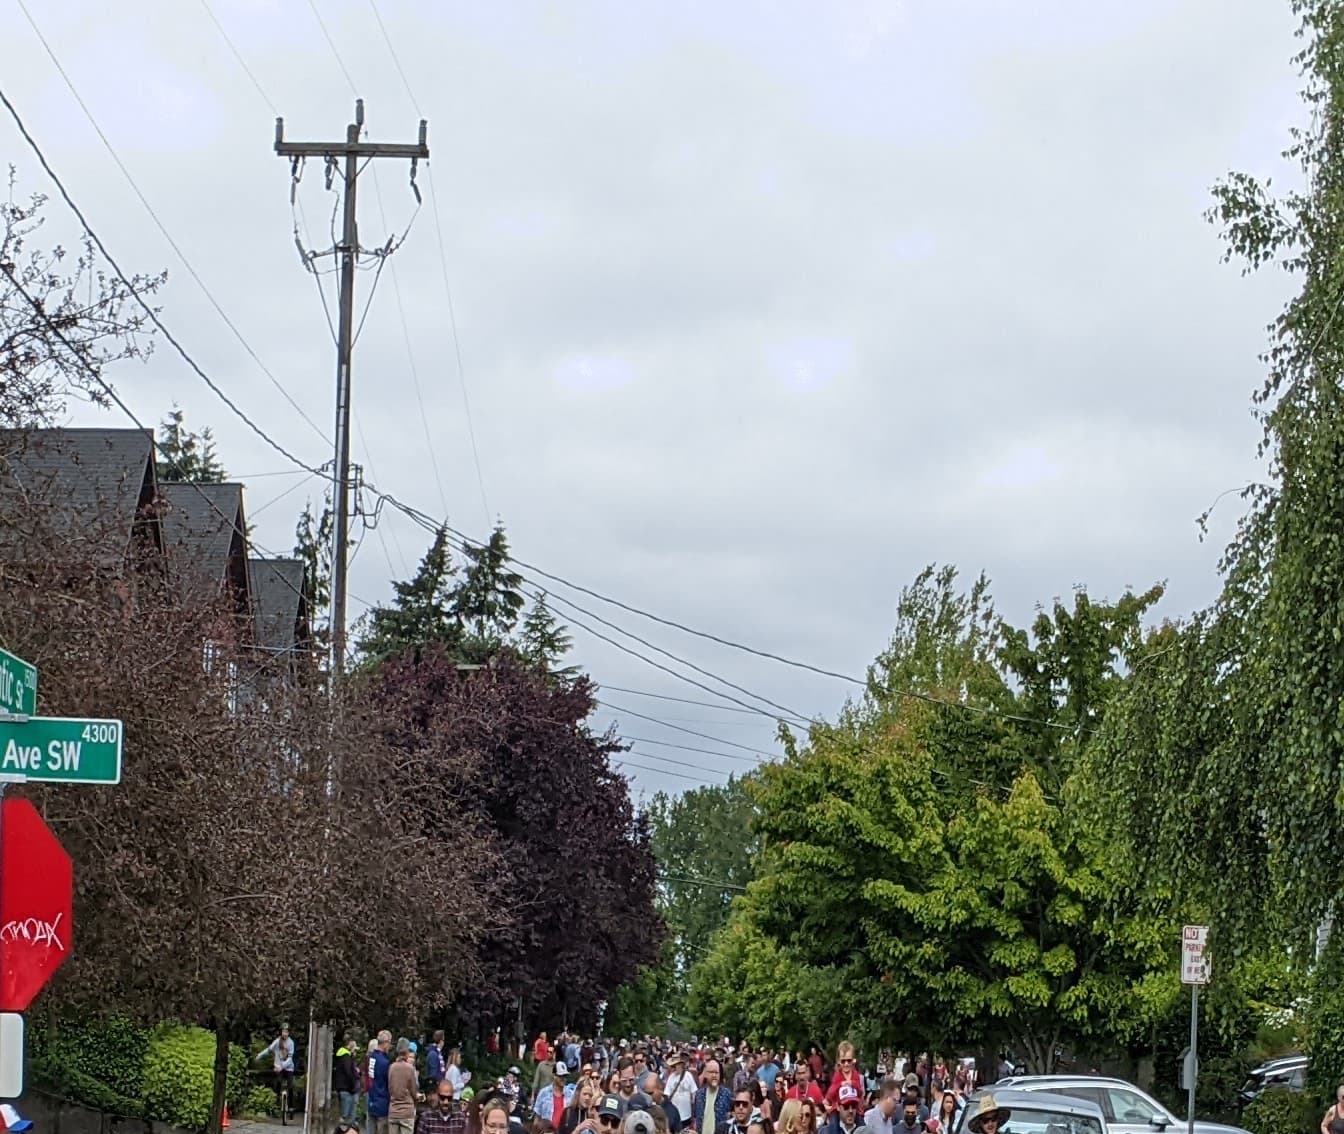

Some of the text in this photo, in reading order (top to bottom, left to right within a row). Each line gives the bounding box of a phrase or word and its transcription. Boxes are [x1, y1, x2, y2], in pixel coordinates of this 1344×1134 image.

[81, 725, 117, 744] 4300
[2, 739, 42, 769] Ave
[47, 740, 81, 771] SW
[1184, 928, 1199, 940] NO
